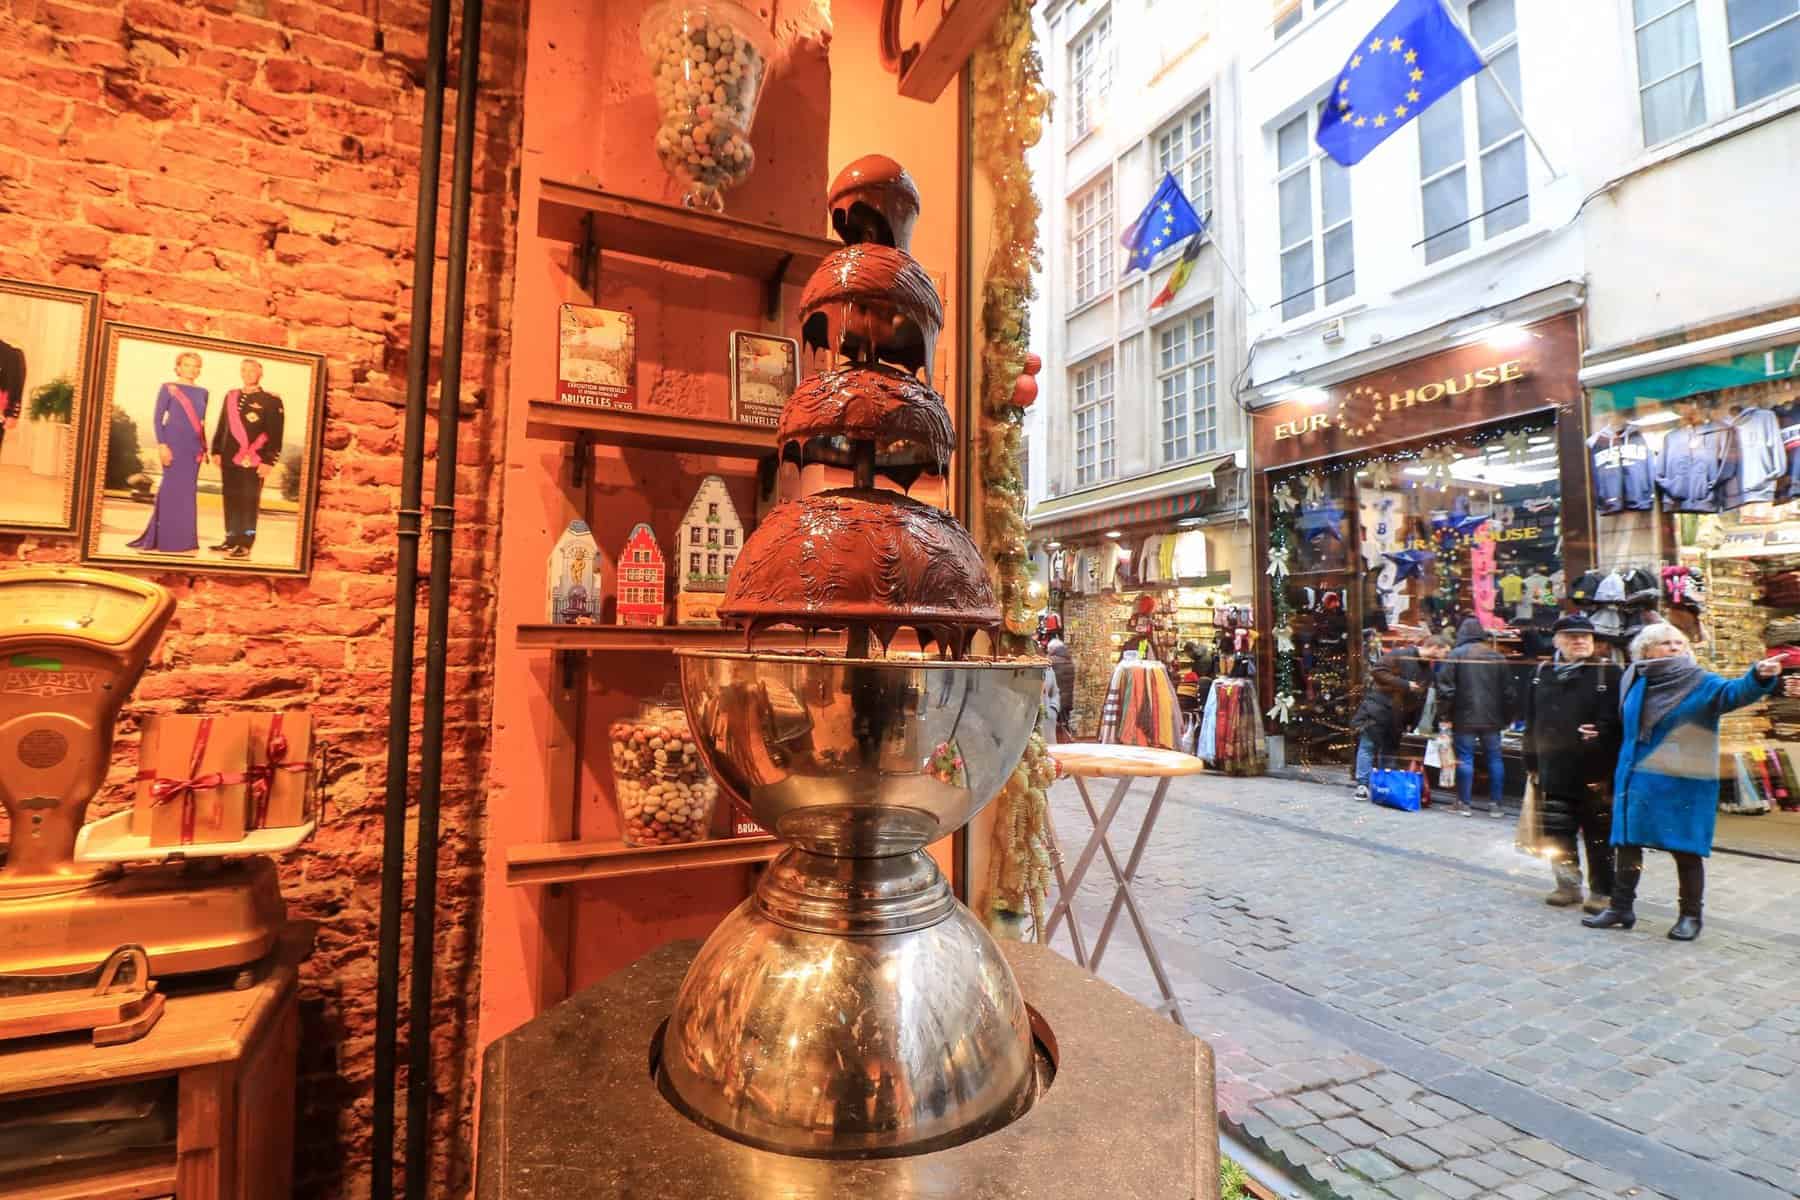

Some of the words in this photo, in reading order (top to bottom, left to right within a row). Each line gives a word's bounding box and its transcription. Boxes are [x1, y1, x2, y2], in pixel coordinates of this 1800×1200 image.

[1389, 360, 1524, 411] HOUSE
[561, 393, 611, 407] BRUXELLES
[4, 671, 96, 689] AVERY
